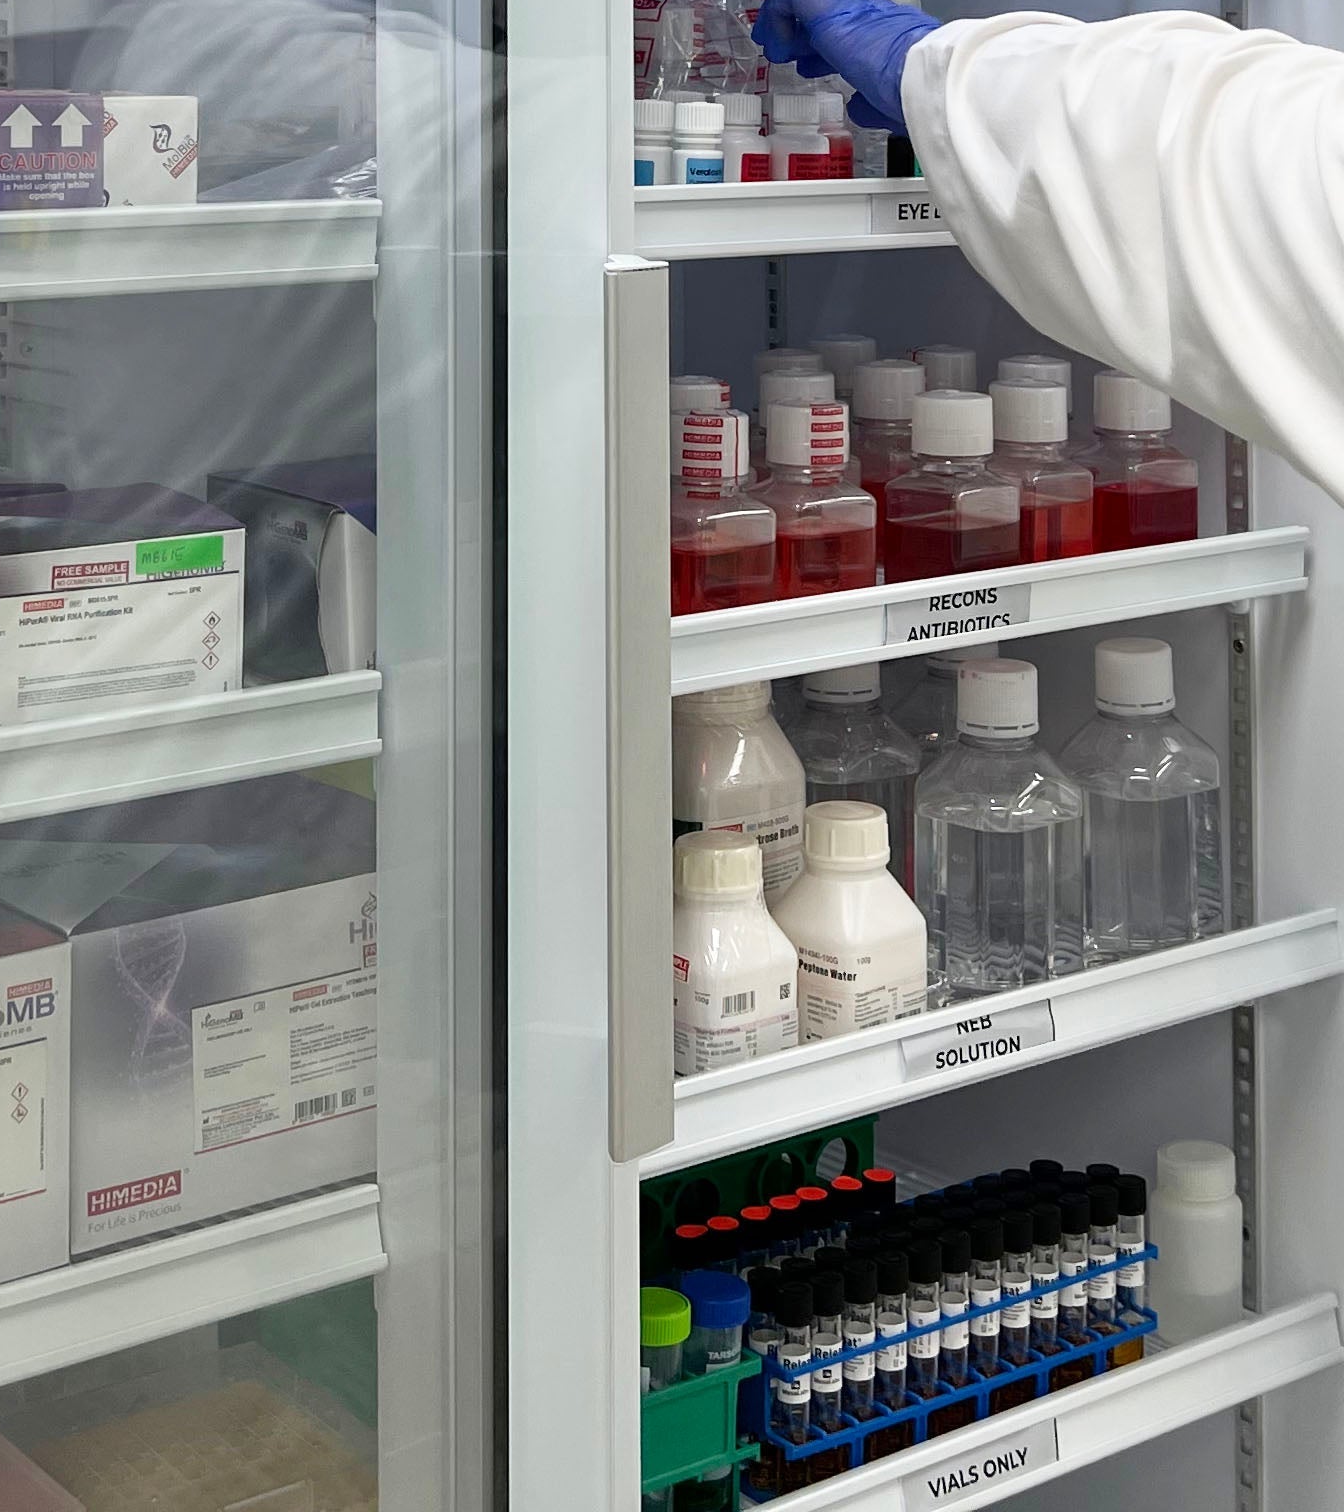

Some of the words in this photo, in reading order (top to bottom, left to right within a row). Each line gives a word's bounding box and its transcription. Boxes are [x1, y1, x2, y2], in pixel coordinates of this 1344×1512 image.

[898, 203, 930, 221] EYE
[684, 418, 722, 427] HIMEDIA
[684, 434, 722, 443] HIMEDIA
[684, 451, 722, 460] HIMEDIA
[684, 467, 722, 477] HIMEDIA
[55, 565, 82, 577] FREE
[84, 561, 128, 576] SAMPLE
[24, 599, 63, 612] HIMEDIA
[929, 587, 997, 611] RECONS
[84, 607, 122, 619] Purification
[123, 605, 133, 615] Kit
[907, 613, 1010, 642] ANTIBIOTICS
[798, 958, 829, 976] Peptone
[829, 968, 857, 981] Water
[8, 979, 51, 998] HIMEDIA
[956, 1014, 992, 1035] NEB
[935, 1035, 1021, 1069] SOLUTION
[91, 1175, 178, 1212] HIMEDIA
[87, 1221, 107, 1233] For
[107, 1214, 126, 1230] Life
[129, 1213, 137, 1224] is
[138, 1201, 181, 1221] Precious
[927, 1465, 979, 1498] VIALS
[983, 1447, 1028, 1478] ONLY
